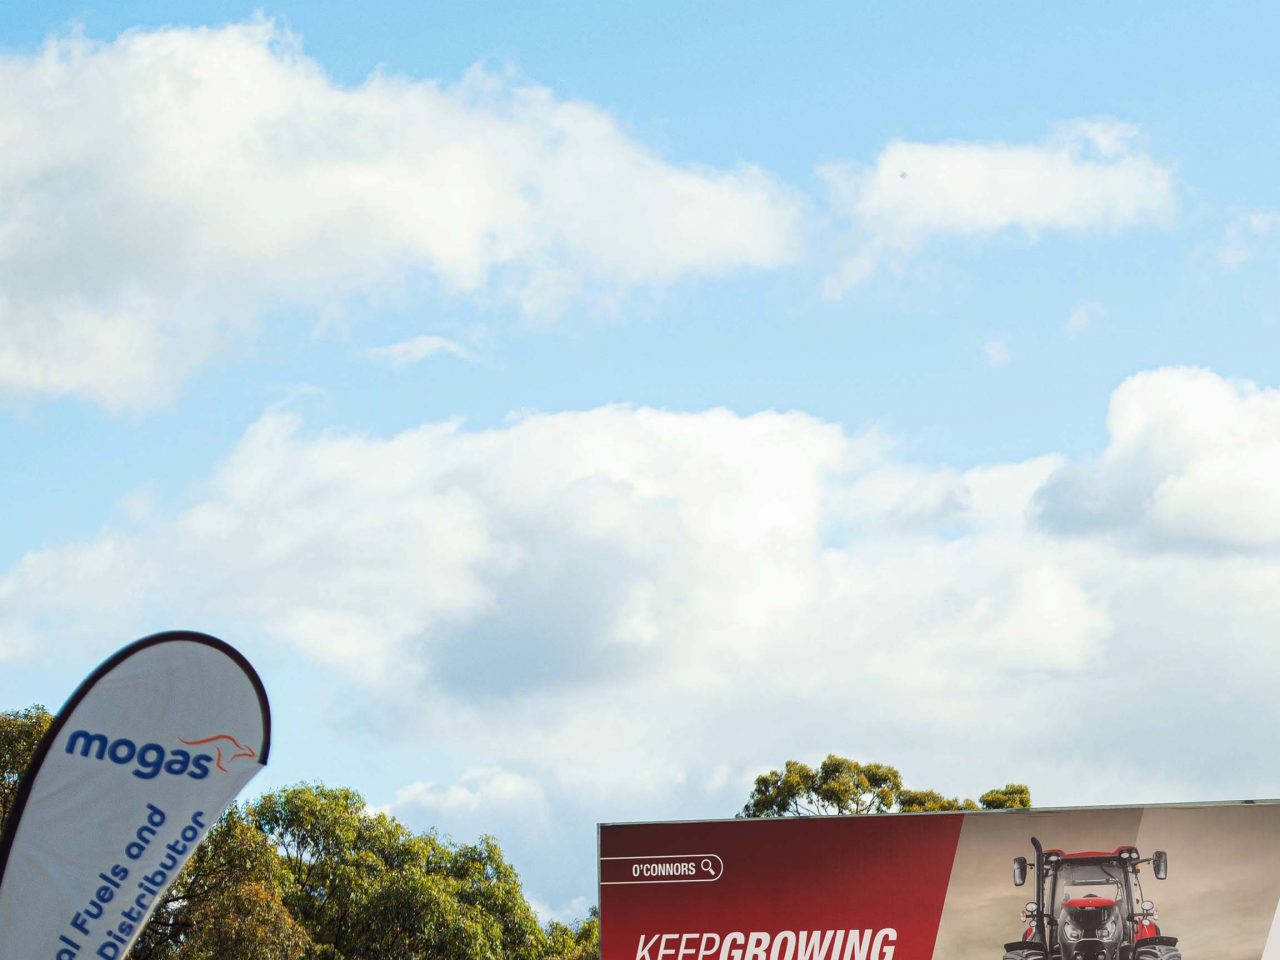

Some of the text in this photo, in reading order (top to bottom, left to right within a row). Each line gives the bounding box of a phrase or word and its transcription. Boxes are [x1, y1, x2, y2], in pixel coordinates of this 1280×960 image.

[65, 728, 213, 780] mogas
[69, 864, 129, 936] Fuels
[124, 803, 167, 860] and
[632, 862, 696, 877] O'CONNORS
